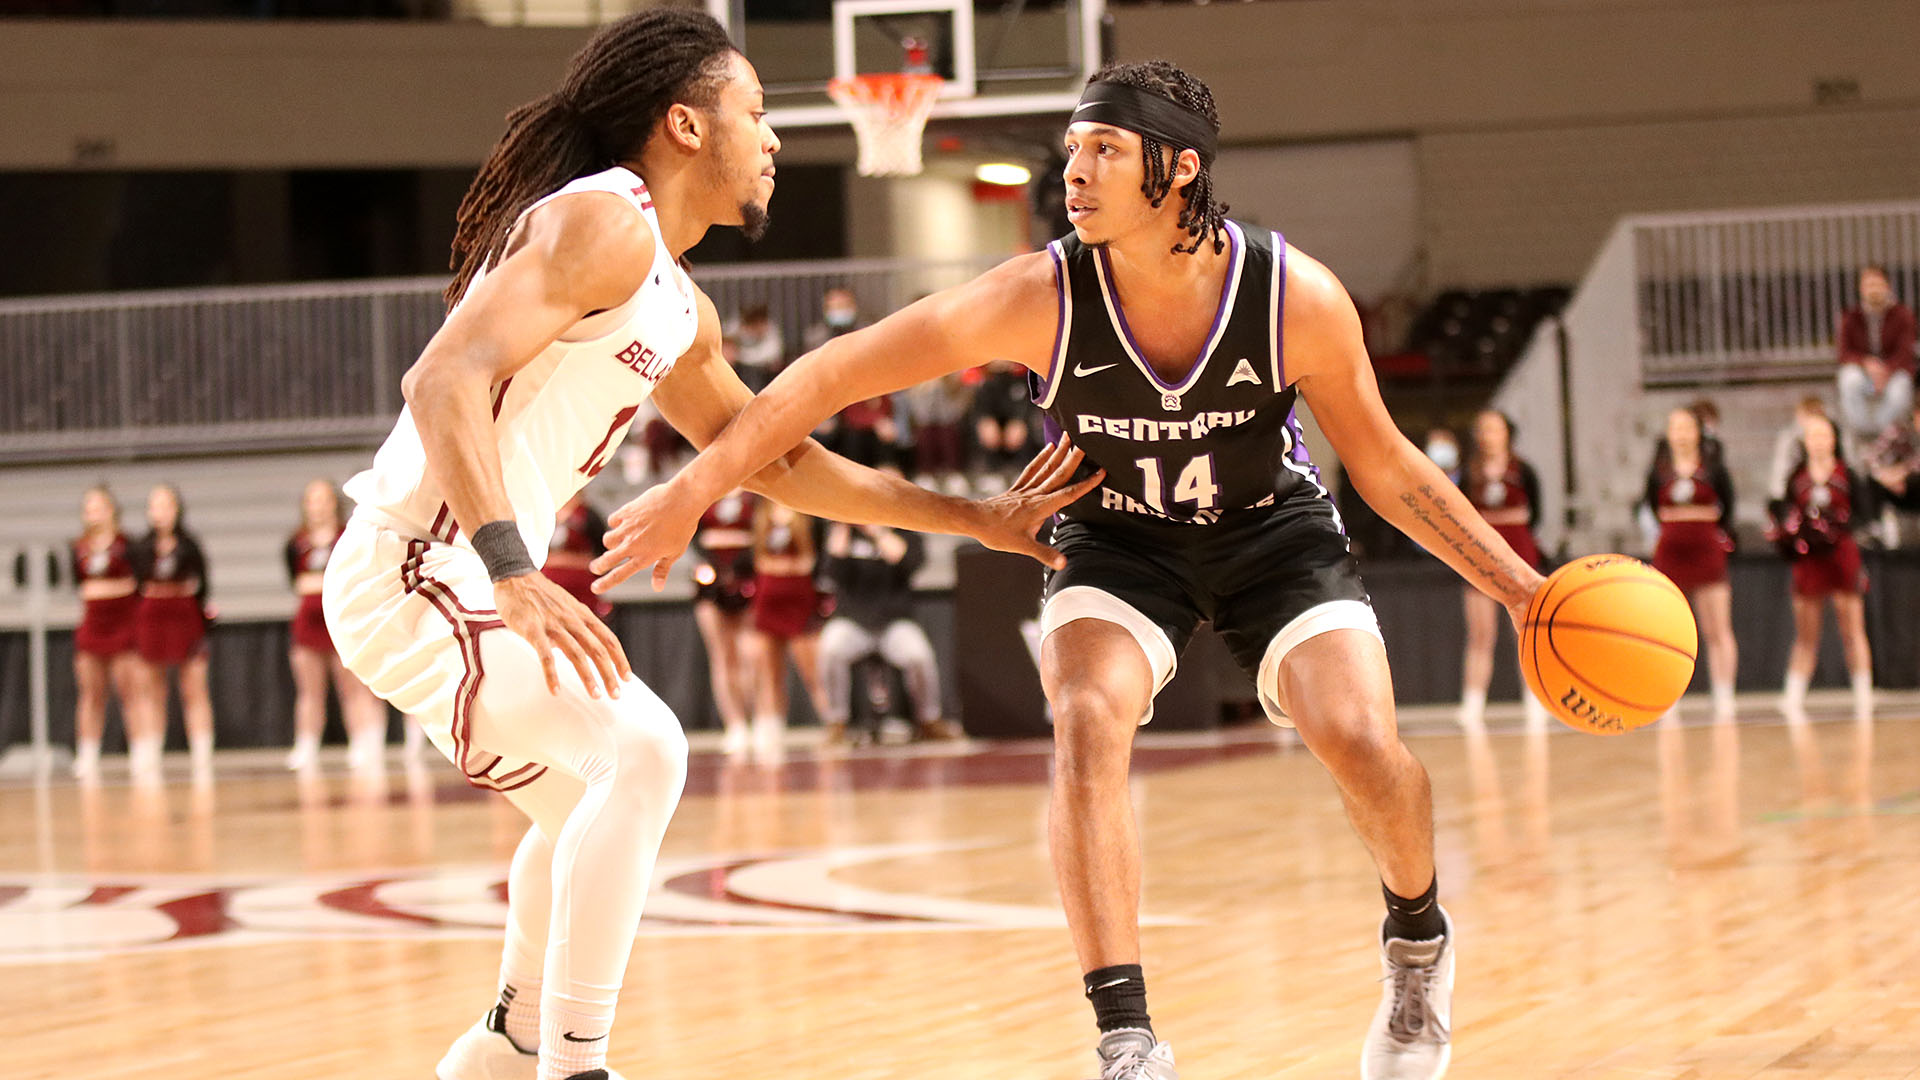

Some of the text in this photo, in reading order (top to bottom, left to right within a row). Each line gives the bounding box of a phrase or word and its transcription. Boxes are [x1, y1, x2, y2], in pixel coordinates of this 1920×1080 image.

[614, 340, 672, 385] BELLA
[578, 403, 640, 478] 1
[1077, 409, 1256, 442] CENTRAL
[1135, 452, 1221, 513] 14
